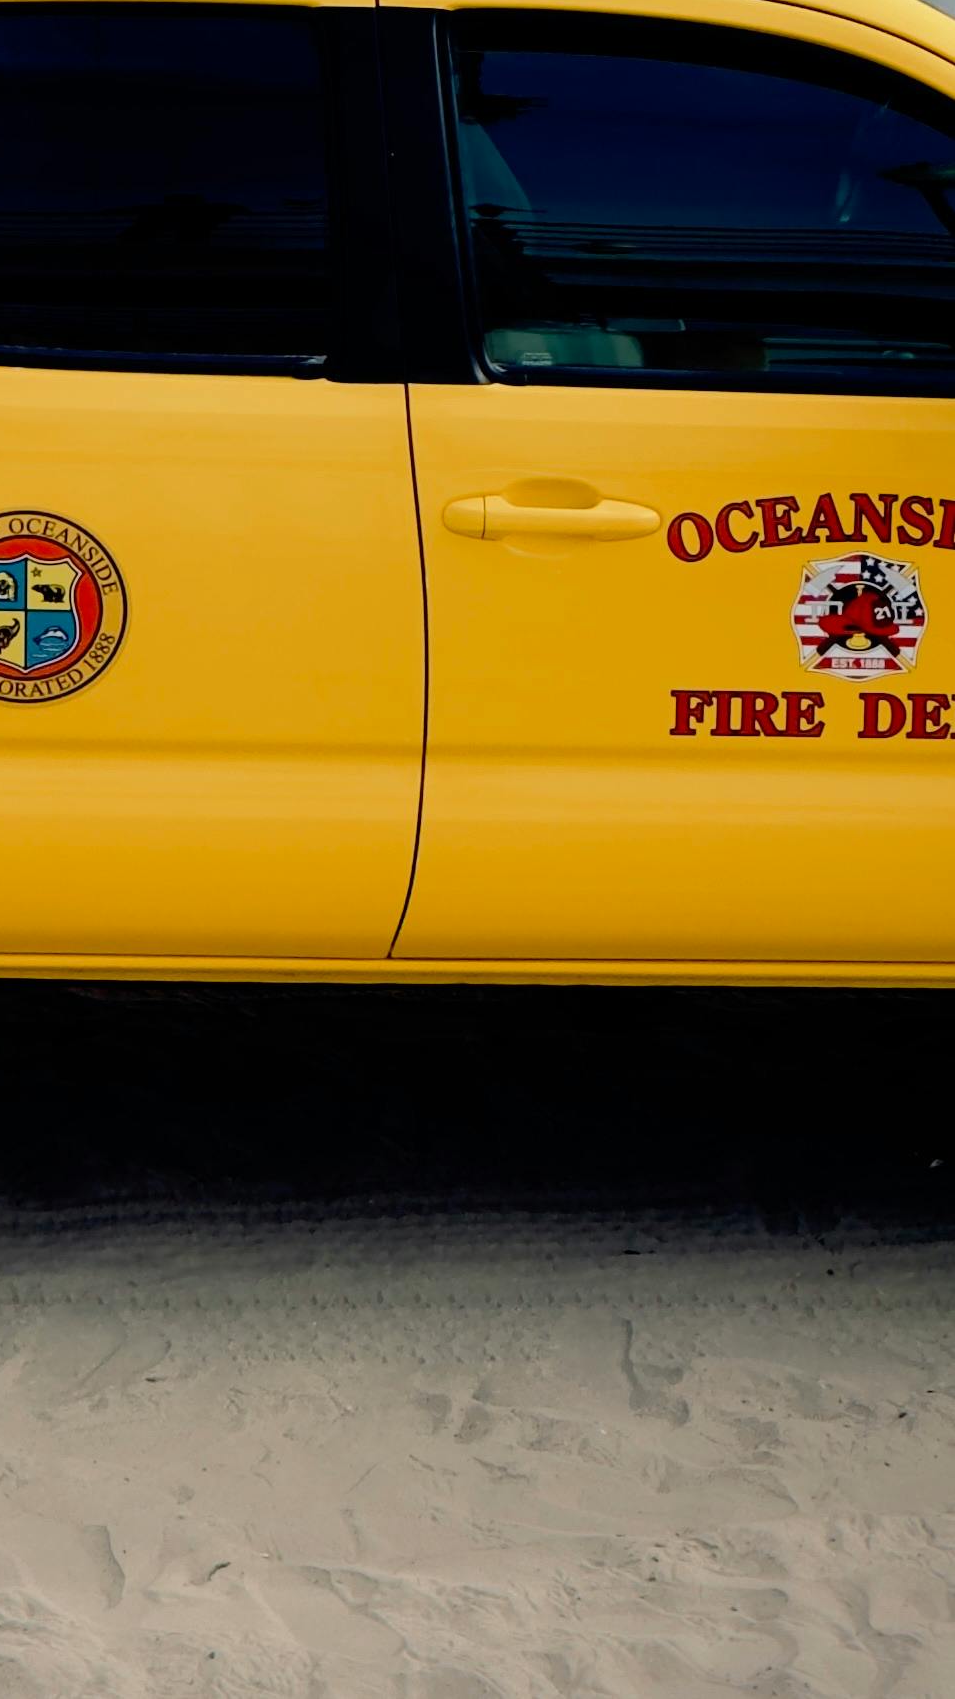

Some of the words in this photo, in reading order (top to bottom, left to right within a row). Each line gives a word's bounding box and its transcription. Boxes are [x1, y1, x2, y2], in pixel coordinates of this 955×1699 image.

[8, 517, 119, 595] OCEANSIDE
[874, 605, 892, 620] 21
[83, 632, 116, 671] 1888
[669, 690, 825, 737] FIRE
[857, 692, 955, 739] DE
